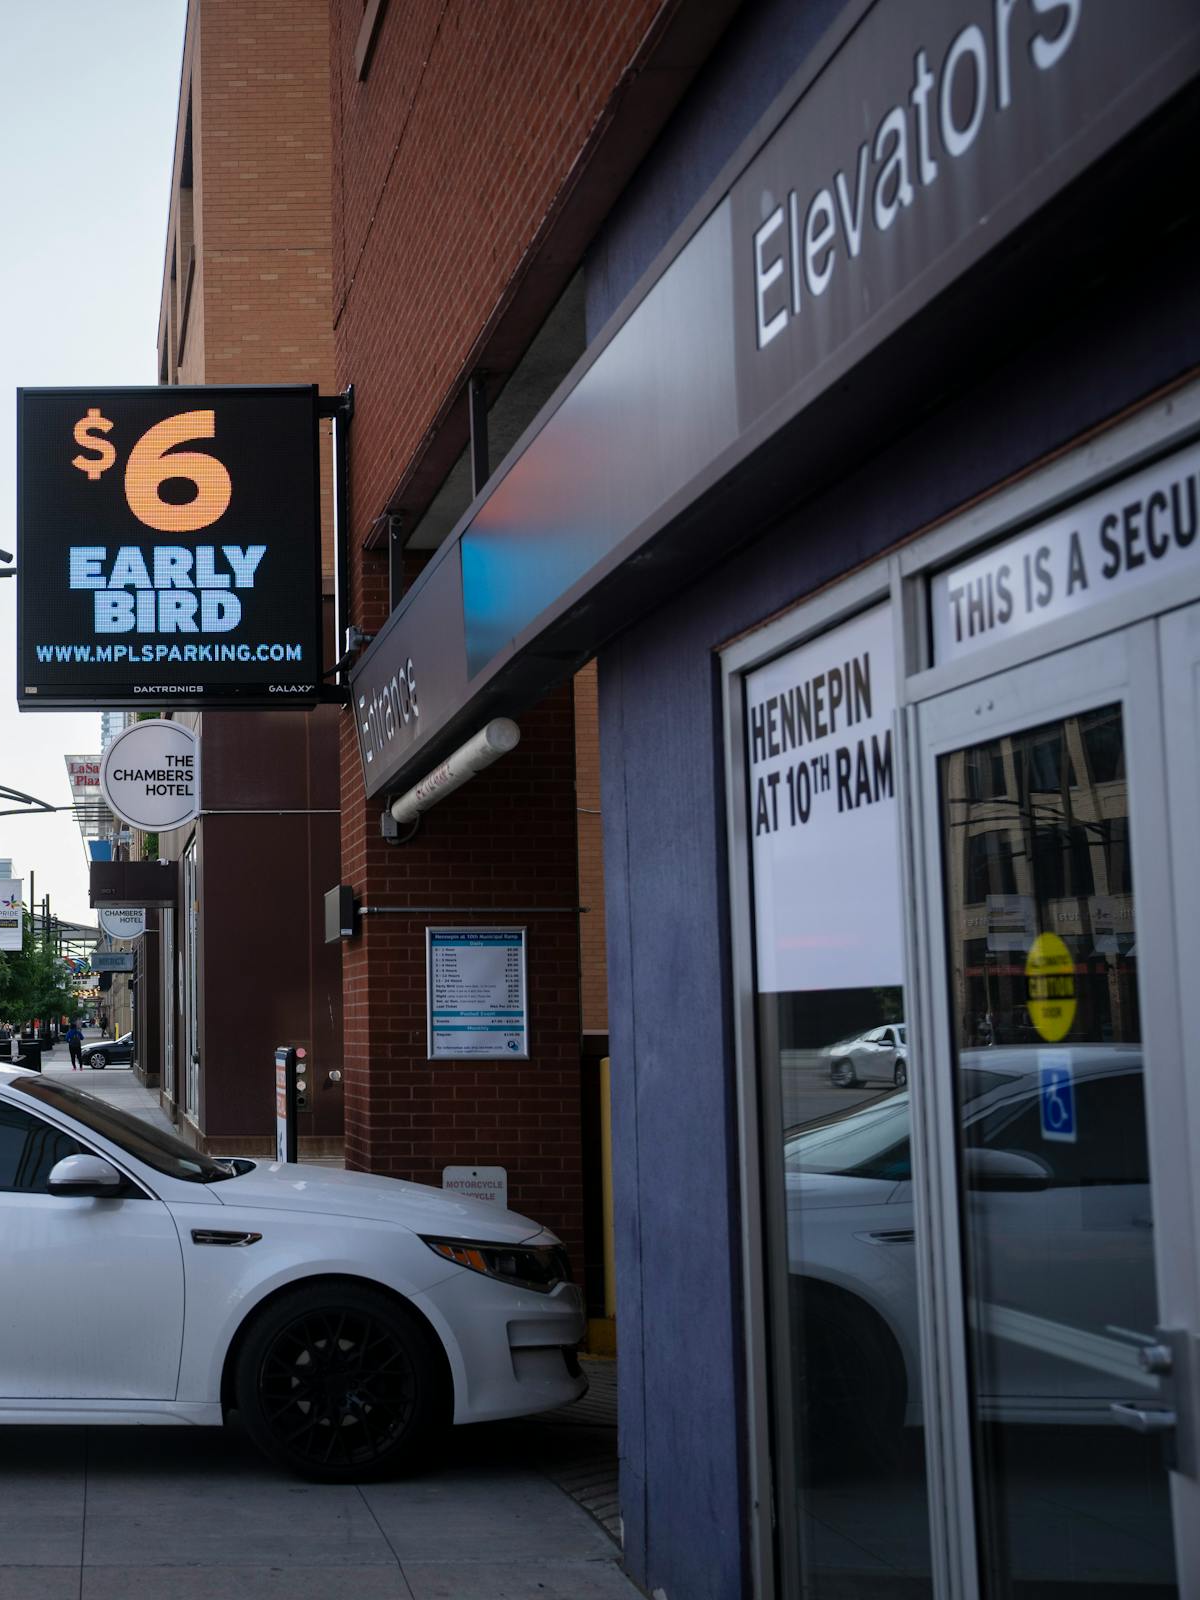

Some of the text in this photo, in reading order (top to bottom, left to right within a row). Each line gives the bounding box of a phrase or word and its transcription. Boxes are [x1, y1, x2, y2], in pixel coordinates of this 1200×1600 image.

[753, 0, 1081, 351] Elevators
[69, 545, 267, 588] EARLY
[949, 565, 1013, 642] THIS
[1023, 546, 1053, 614] IS
[1066, 530, 1089, 597] A
[94, 590, 241, 633] BIRD
[36, 644, 302, 662] WWW.MPLSPARKING.COM
[133, 685, 312, 693] DAKTRONICS GALAXY
[359, 658, 419, 763] Entrance
[751, 652, 872, 764] HENNEPIN
[70, 763, 100, 774] LaSa
[113, 769, 194, 781] CHAMBERS
[165, 755, 194, 766] THE
[146, 784, 194, 796] HOTEL
[756, 771, 781, 836] AT
[786, 753, 830, 826] 10TH
[447, 1181, 504, 1189] MOTORCYCLE
